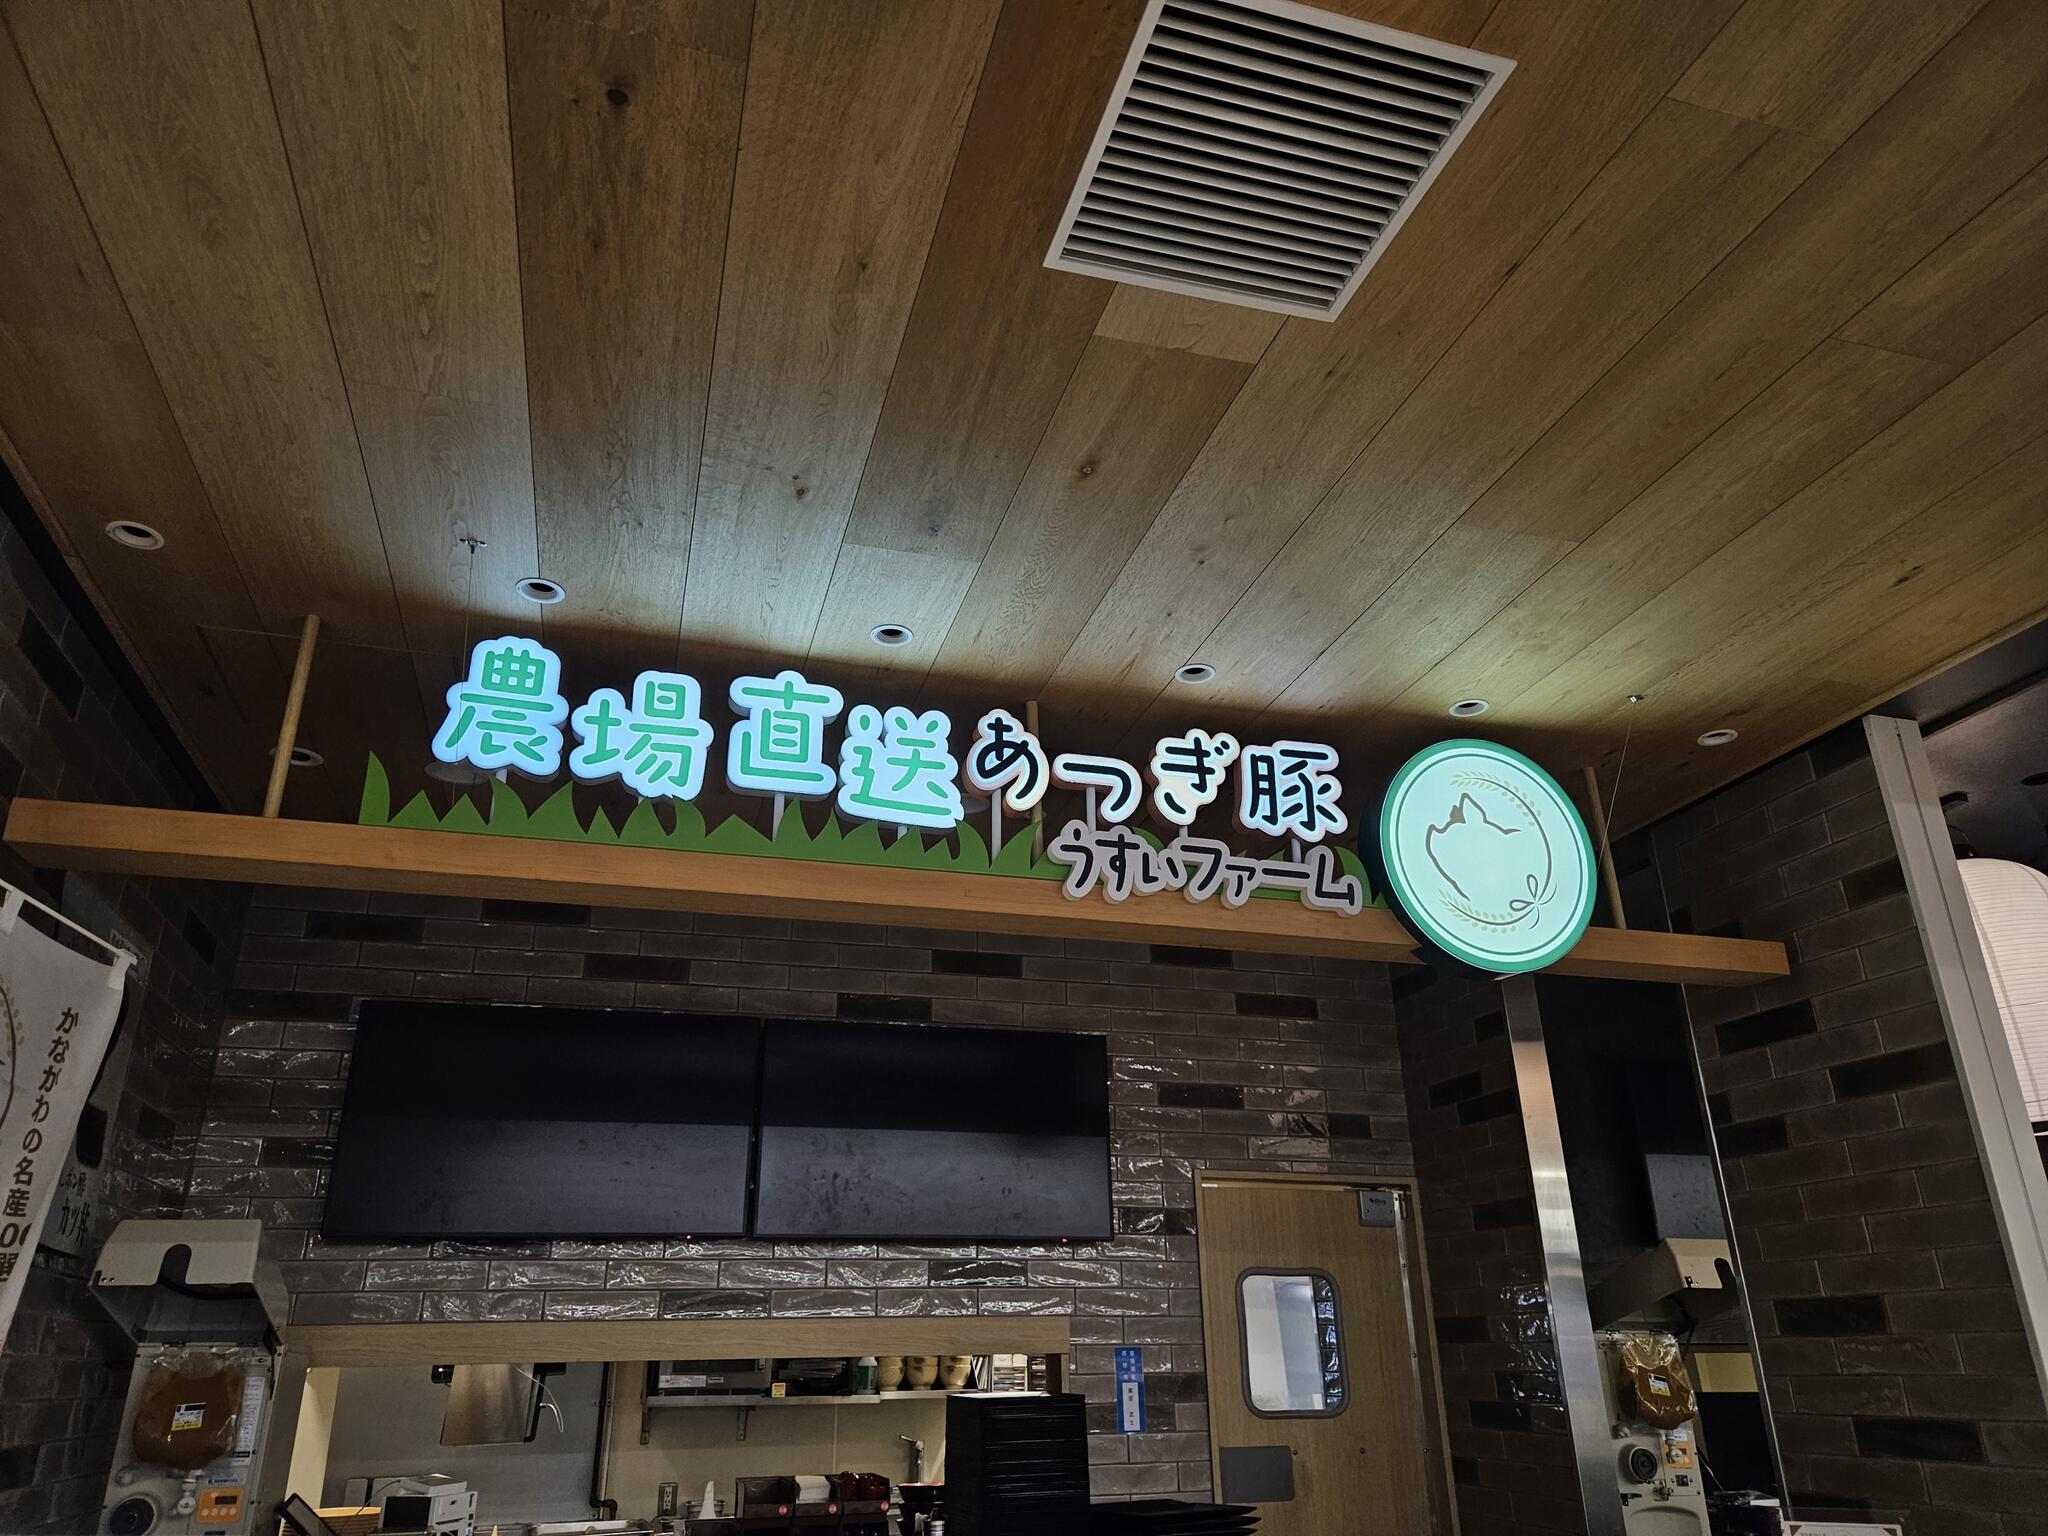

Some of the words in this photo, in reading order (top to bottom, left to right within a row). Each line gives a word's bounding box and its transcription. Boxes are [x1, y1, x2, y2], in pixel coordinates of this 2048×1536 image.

[444, 646, 953, 817] 農場直送
[976, 716, 1338, 831] あつぎ豚
[1059, 827, 1356, 906] うすいファーム
